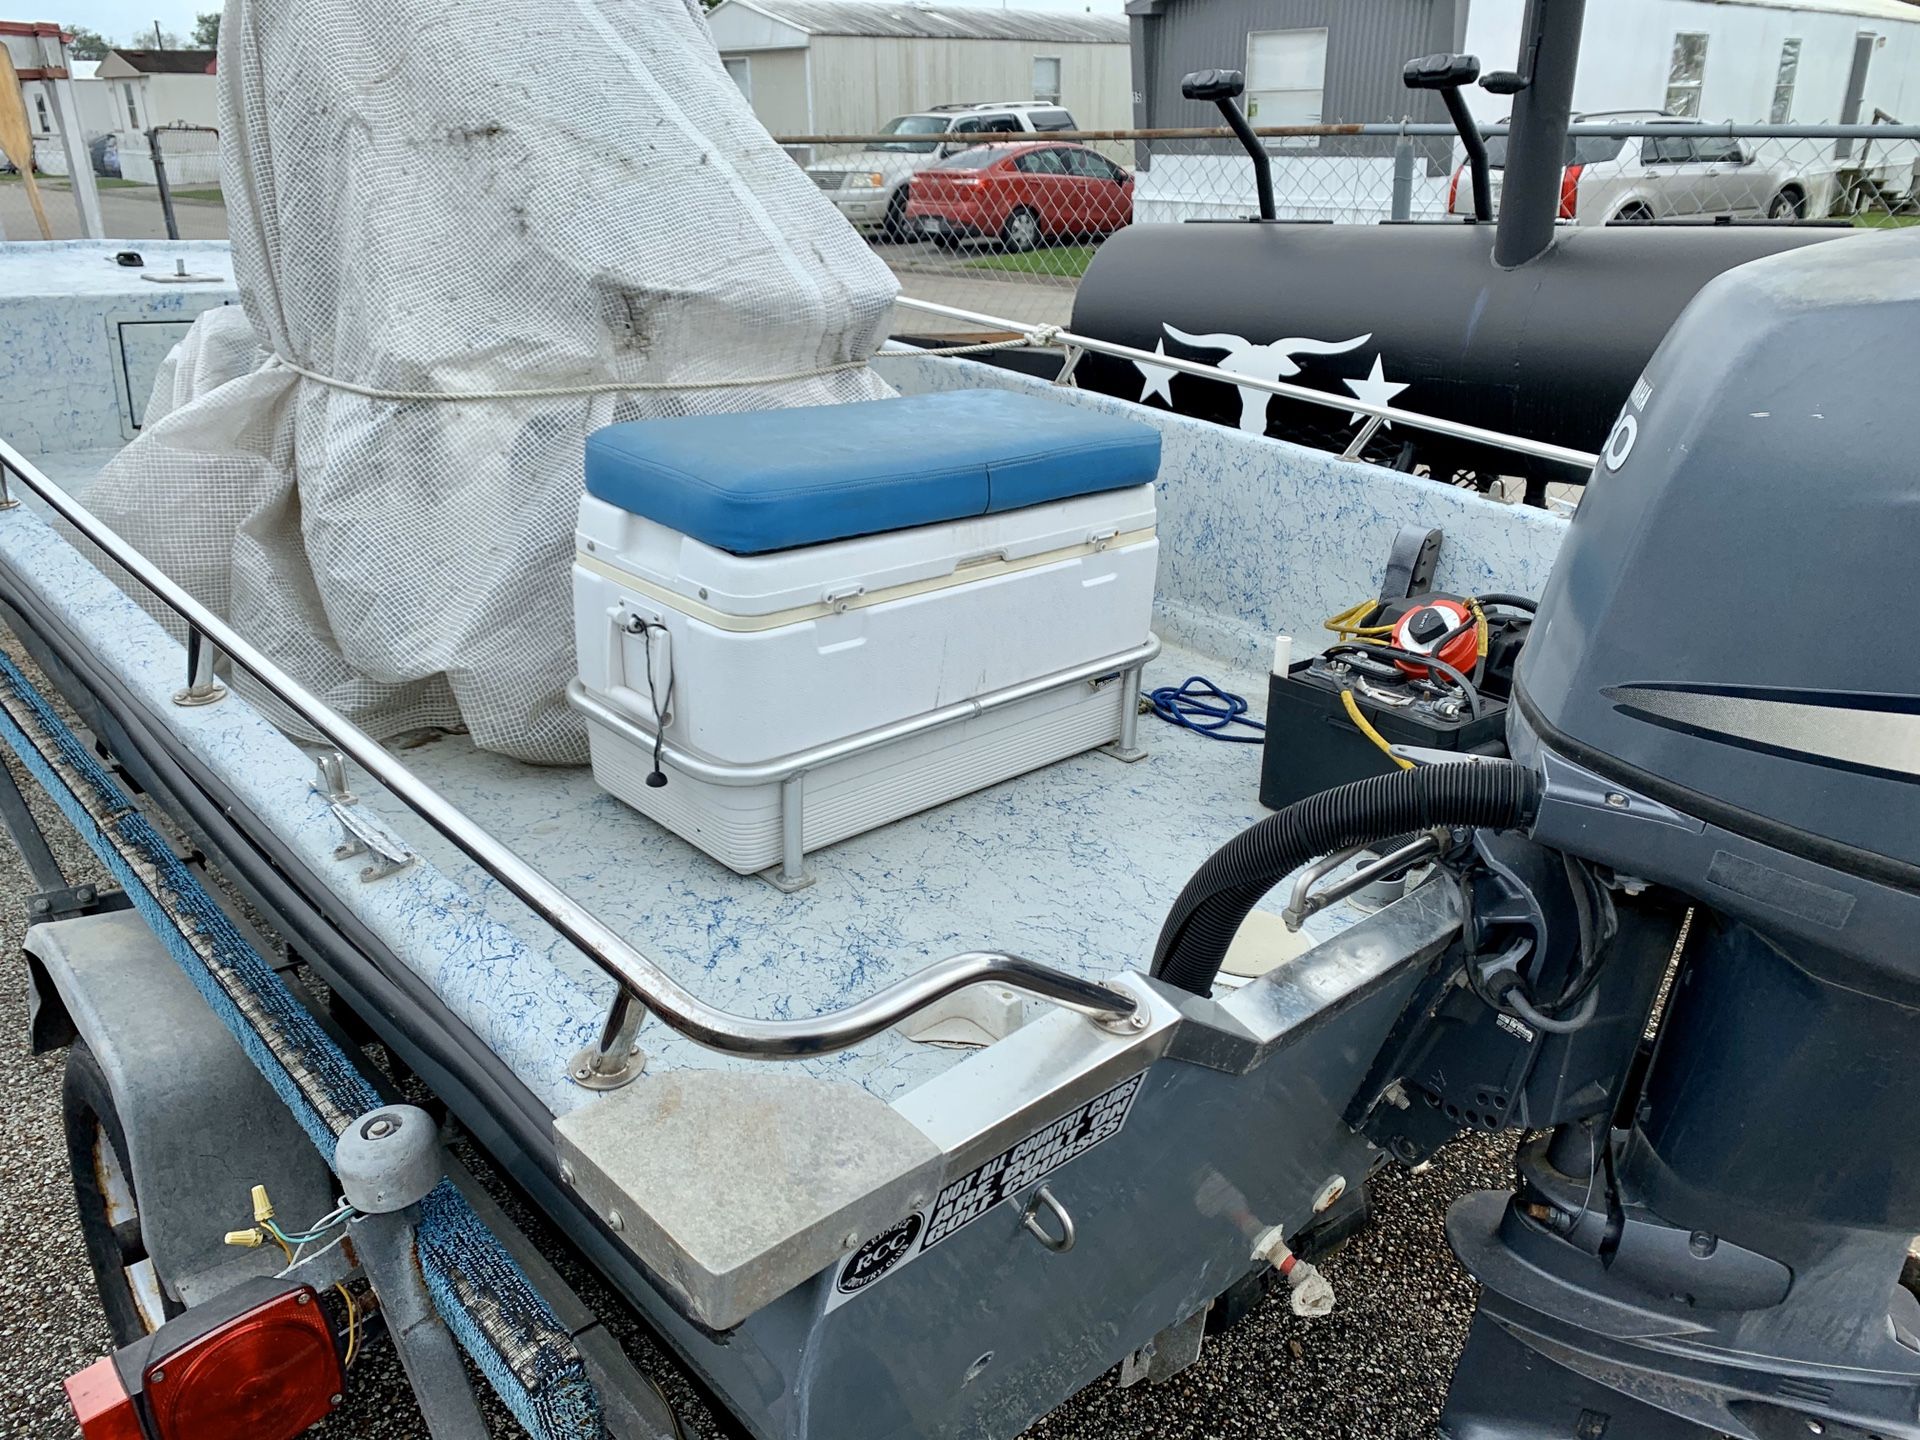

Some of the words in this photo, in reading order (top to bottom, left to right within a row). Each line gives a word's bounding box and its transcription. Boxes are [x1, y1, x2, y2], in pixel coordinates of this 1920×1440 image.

[1602, 402, 1638, 471] 0
[924, 1190, 997, 1246] GOLF
[1001, 1116, 1122, 1198] COURSES
[930, 1176, 995, 1229] ARE
[999, 1122, 1086, 1186] BUILT
[1090, 1096, 1131, 1130] ON
[937, 1172, 977, 1210] NOT
[976, 1153, 1008, 1186] ALL
[1010, 1106, 1088, 1165] COUNTRY
[1087, 1077, 1140, 1118] CLUBS
[854, 1230, 908, 1275] RCC
